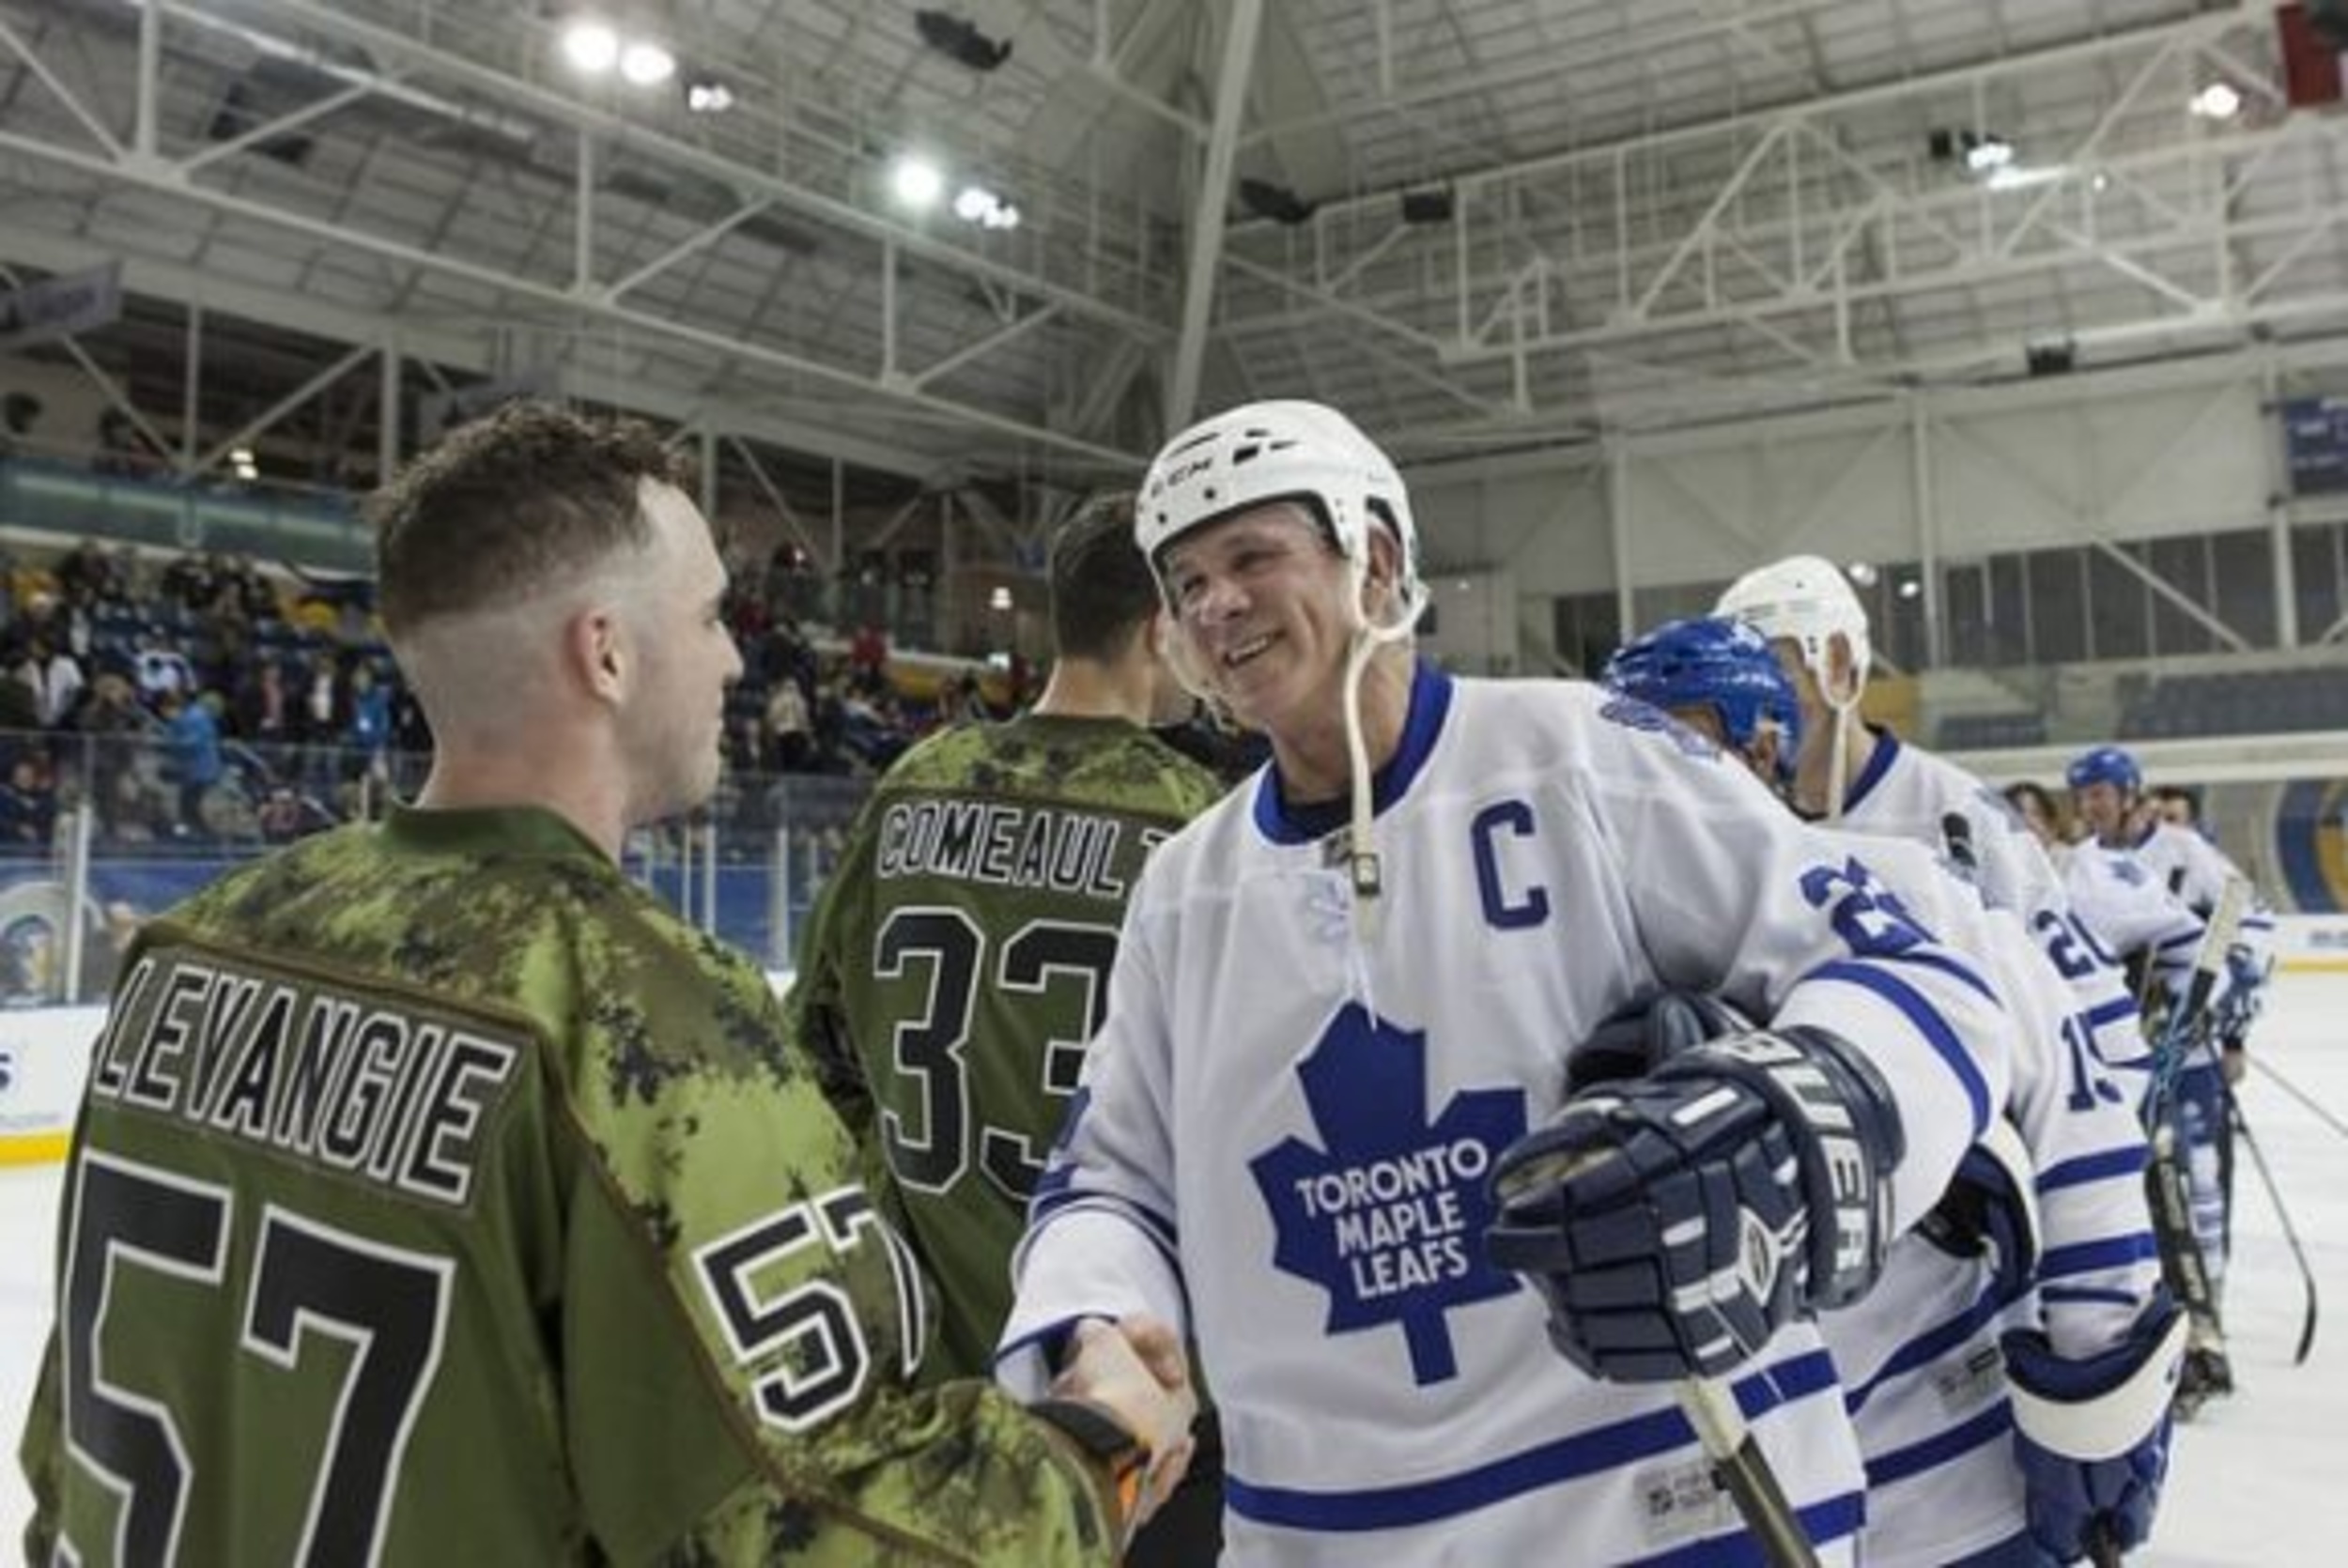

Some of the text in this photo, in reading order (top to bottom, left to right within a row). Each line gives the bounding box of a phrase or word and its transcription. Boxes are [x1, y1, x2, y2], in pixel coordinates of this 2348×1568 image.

[878, 800, 1166, 897] COMEAUL
[1471, 799, 1550, 930] C
[93, 958, 517, 1203] LEVANGIE
[873, 906, 1124, 1199] 33
[1296, 1138, 1490, 1219] TORONTO
[1335, 1192, 1465, 1259] MAPLE
[691, 1183, 924, 1430] 57
[1349, 1237, 1469, 1300] LEAFS
[58, 1148, 456, 1568] 57
